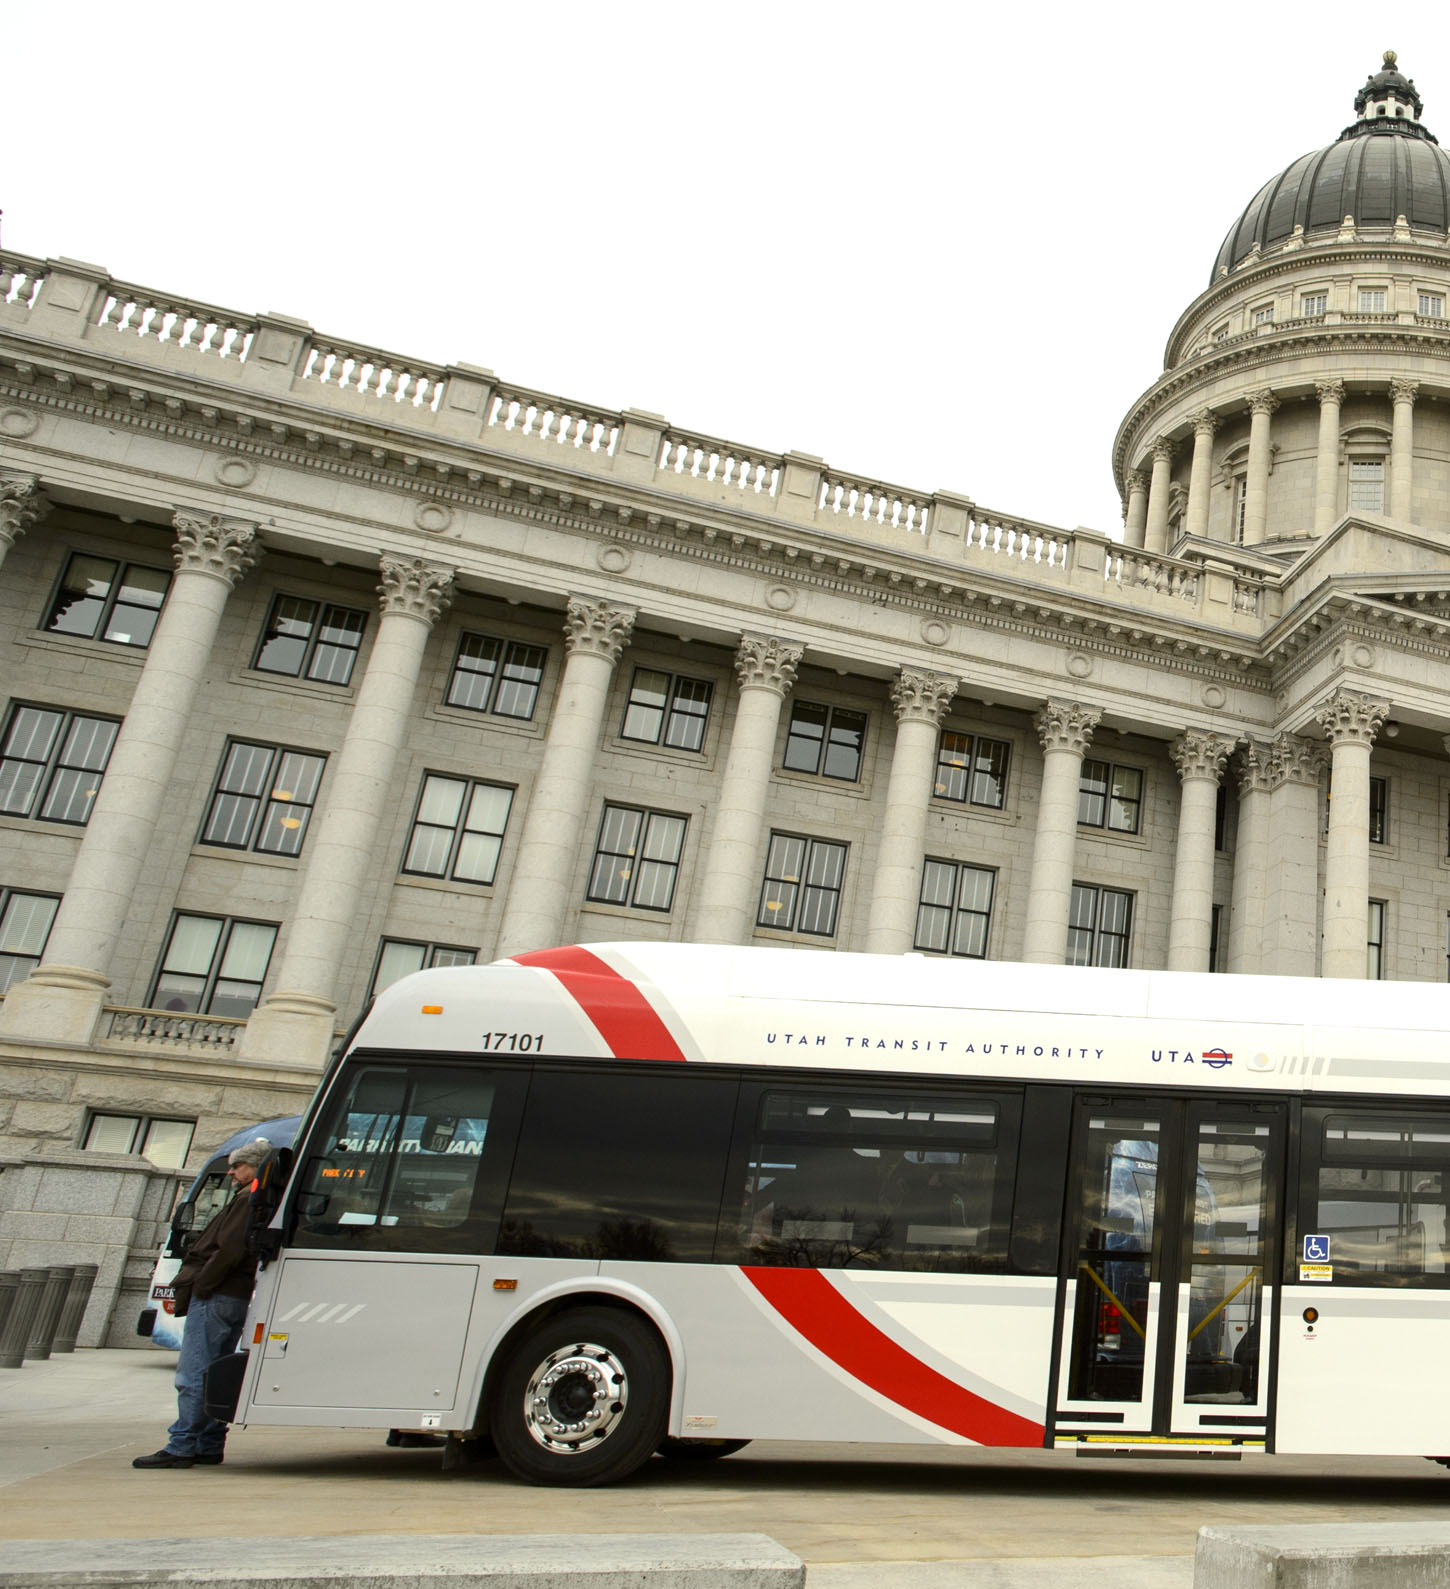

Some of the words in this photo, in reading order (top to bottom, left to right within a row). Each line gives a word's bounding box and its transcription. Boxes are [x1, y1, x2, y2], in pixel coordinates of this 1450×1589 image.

[482, 1032, 544, 1052] 17101
[766, 1033, 826, 1046] UTAH
[845, 1037, 948, 1052] TRANSIT
[965, 1043, 1104, 1060] AUTHORITY
[1151, 1050, 1195, 1063] UTA
